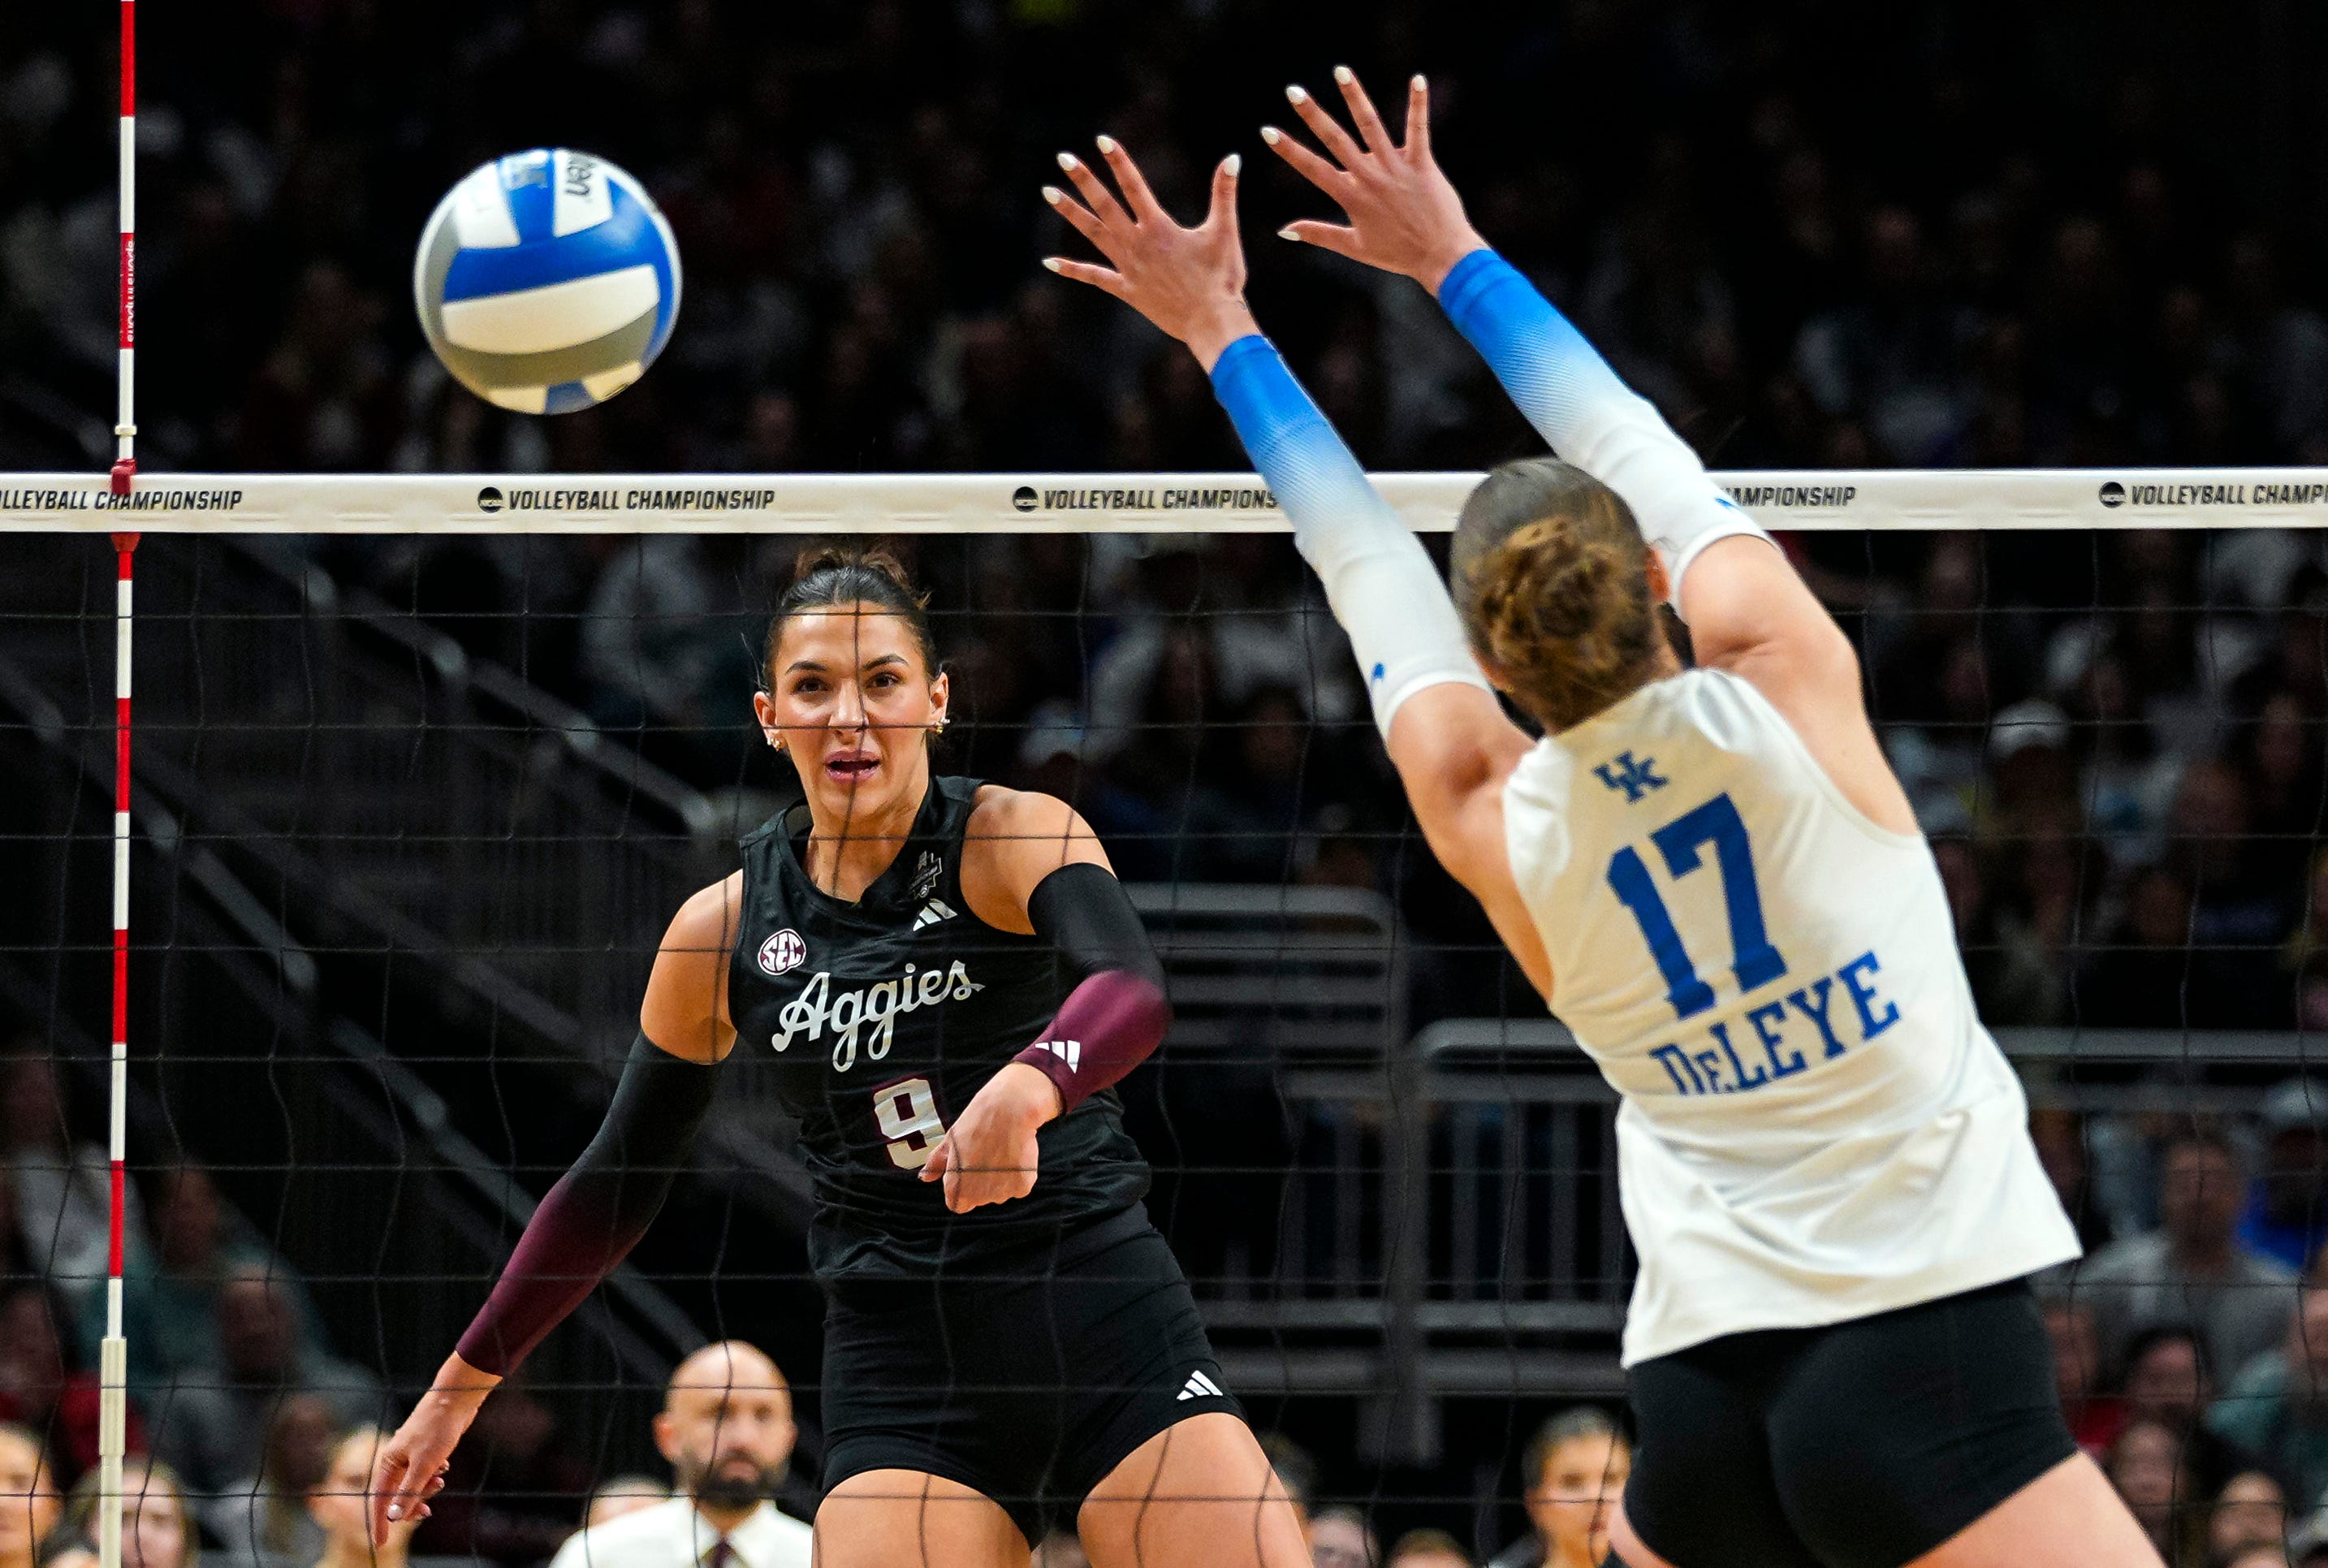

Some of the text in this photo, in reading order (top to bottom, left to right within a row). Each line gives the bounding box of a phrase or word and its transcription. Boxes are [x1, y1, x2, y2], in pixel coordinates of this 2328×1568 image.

[0, 490, 242, 510] LLEYBALL CHAMPIONSHIP
[509, 490, 620, 510] VOLLEYBALL
[626, 490, 775, 510] CHAMPIONSHIP
[1044, 490, 1155, 509] VOLLEYBALL
[1725, 487, 1855, 507] AMPIONSHIP
[2131, 486, 2244, 505] VOLLEYBALL
[1592, 749, 1669, 804] UK
[1606, 793, 1788, 1022] 17
[759, 931, 805, 974] SEC
[771, 959, 986, 1072] Aggies
[873, 1078, 946, 1170] 9
